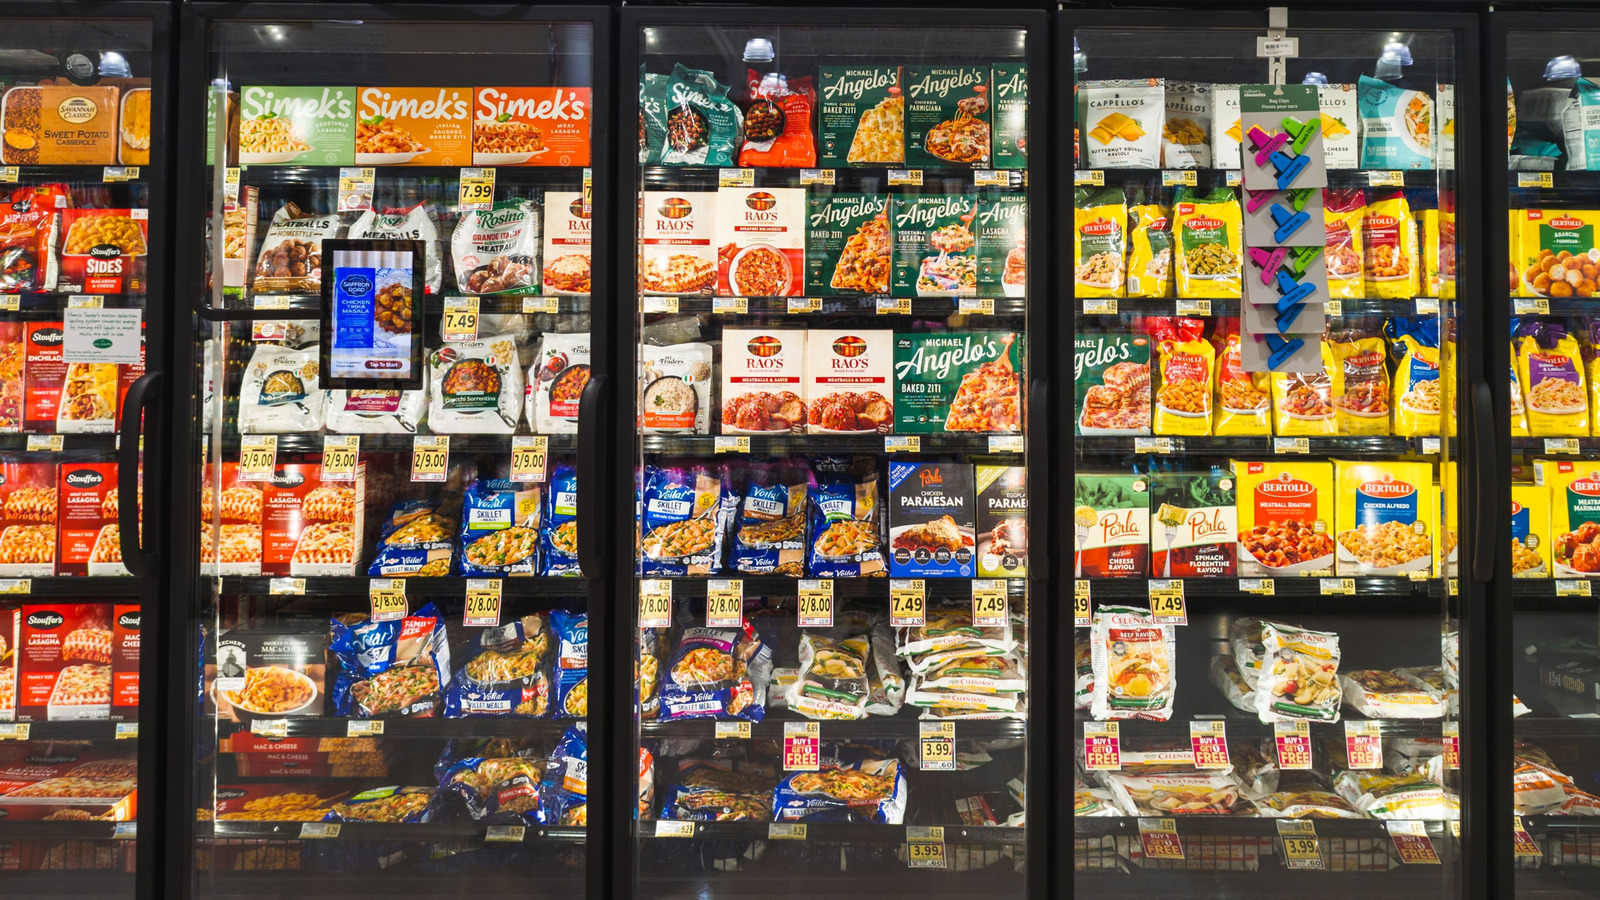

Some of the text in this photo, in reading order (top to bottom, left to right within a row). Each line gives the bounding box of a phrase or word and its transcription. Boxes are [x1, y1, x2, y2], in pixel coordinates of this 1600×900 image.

[824, 69, 896, 100] Angelo's
[909, 68, 982, 100] Angelo's
[243, 87, 351, 121] Simek's
[359, 90, 468, 121] Simek's
[476, 88, 585, 121] Simek's
[1090, 99, 1144, 108] CAPPELLO'S
[823, 106, 856, 114] BAKED ZITI
[44, 130, 109, 139] SWEET POTATO
[822, 171, 833, 179] 9.99
[910, 171, 922, 179] 9.99
[996, 172, 1008, 180] 9.99
[1091, 172, 1103, 180] 10.99
[1184, 173, 1196, 181] 11.39
[463, 184, 492, 198] 7.99
[745, 212, 778, 221] RAO'S
[810, 196, 884, 228] Angelo's
[896, 196, 970, 228] Angelo's
[480, 211, 524, 229] Rosina
[656, 220, 693, 231] RAO'S
[91, 247, 121, 257] Stouffer's
[86, 259, 122, 273] SIDES
[810, 300, 821, 308] 9.99
[898, 300, 910, 308] 9.99
[981, 300, 993, 309] 9.99
[447, 314, 475, 329] 7.49
[926, 339, 963, 347] MICHAEL
[832, 358, 868, 369] RAO'S
[895, 336, 997, 380] Angelo's
[1349, 355, 1382, 364] BERTOLLI
[746, 359, 783, 369] RAO'S
[902, 383, 941, 393] BAKED ZITI
[244, 453, 273, 467] 2/9.00
[325, 453, 355, 467] 2/9.00
[415, 453, 445, 468] 2/9.00
[514, 453, 544, 468] 2/9.00
[67, 474, 102, 483] Stouffer's
[1263, 483, 1309, 493] BERTOLLI
[1364, 484, 1410, 493] BERTOLLI
[656, 501, 682, 510] SKILLET
[752, 498, 777, 510] SKILLET
[901, 496, 963, 507] PARMESAN
[477, 510, 502, 518] SKILLET
[1099, 510, 1141, 543] Parla
[392, 580, 403, 589] 6.29
[489, 581, 500, 589] 6.29
[730, 582, 741, 590] 7.99
[821, 581, 831, 589] 6.29
[1262, 581, 1273, 589] 8.49
[373, 595, 404, 610] 2/8.00
[468, 597, 498, 611] 2/8.00
[709, 598, 739, 612] 2/8.00
[800, 597, 830, 612] 2/8.00
[893, 597, 923, 611] 7.49
[975, 597, 1004, 611] 7.49
[1152, 596, 1182, 611] 7.49
[28, 615, 63, 625] Stouffer's
[952, 695, 985, 703] CELENTANO
[926, 742, 949, 756] 3.99
[787, 753, 816, 764] FREE
[1088, 753, 1117, 764] FREE
[1196, 752, 1227, 763] FREE
[1281, 752, 1310, 764] FREE
[1350, 753, 1379, 764] FREE
[913, 844, 939, 856] 3.99
[1147, 845, 1180, 855] FREE
[1289, 840, 1315, 854] 3.99
[1402, 848, 1434, 860] FREE
